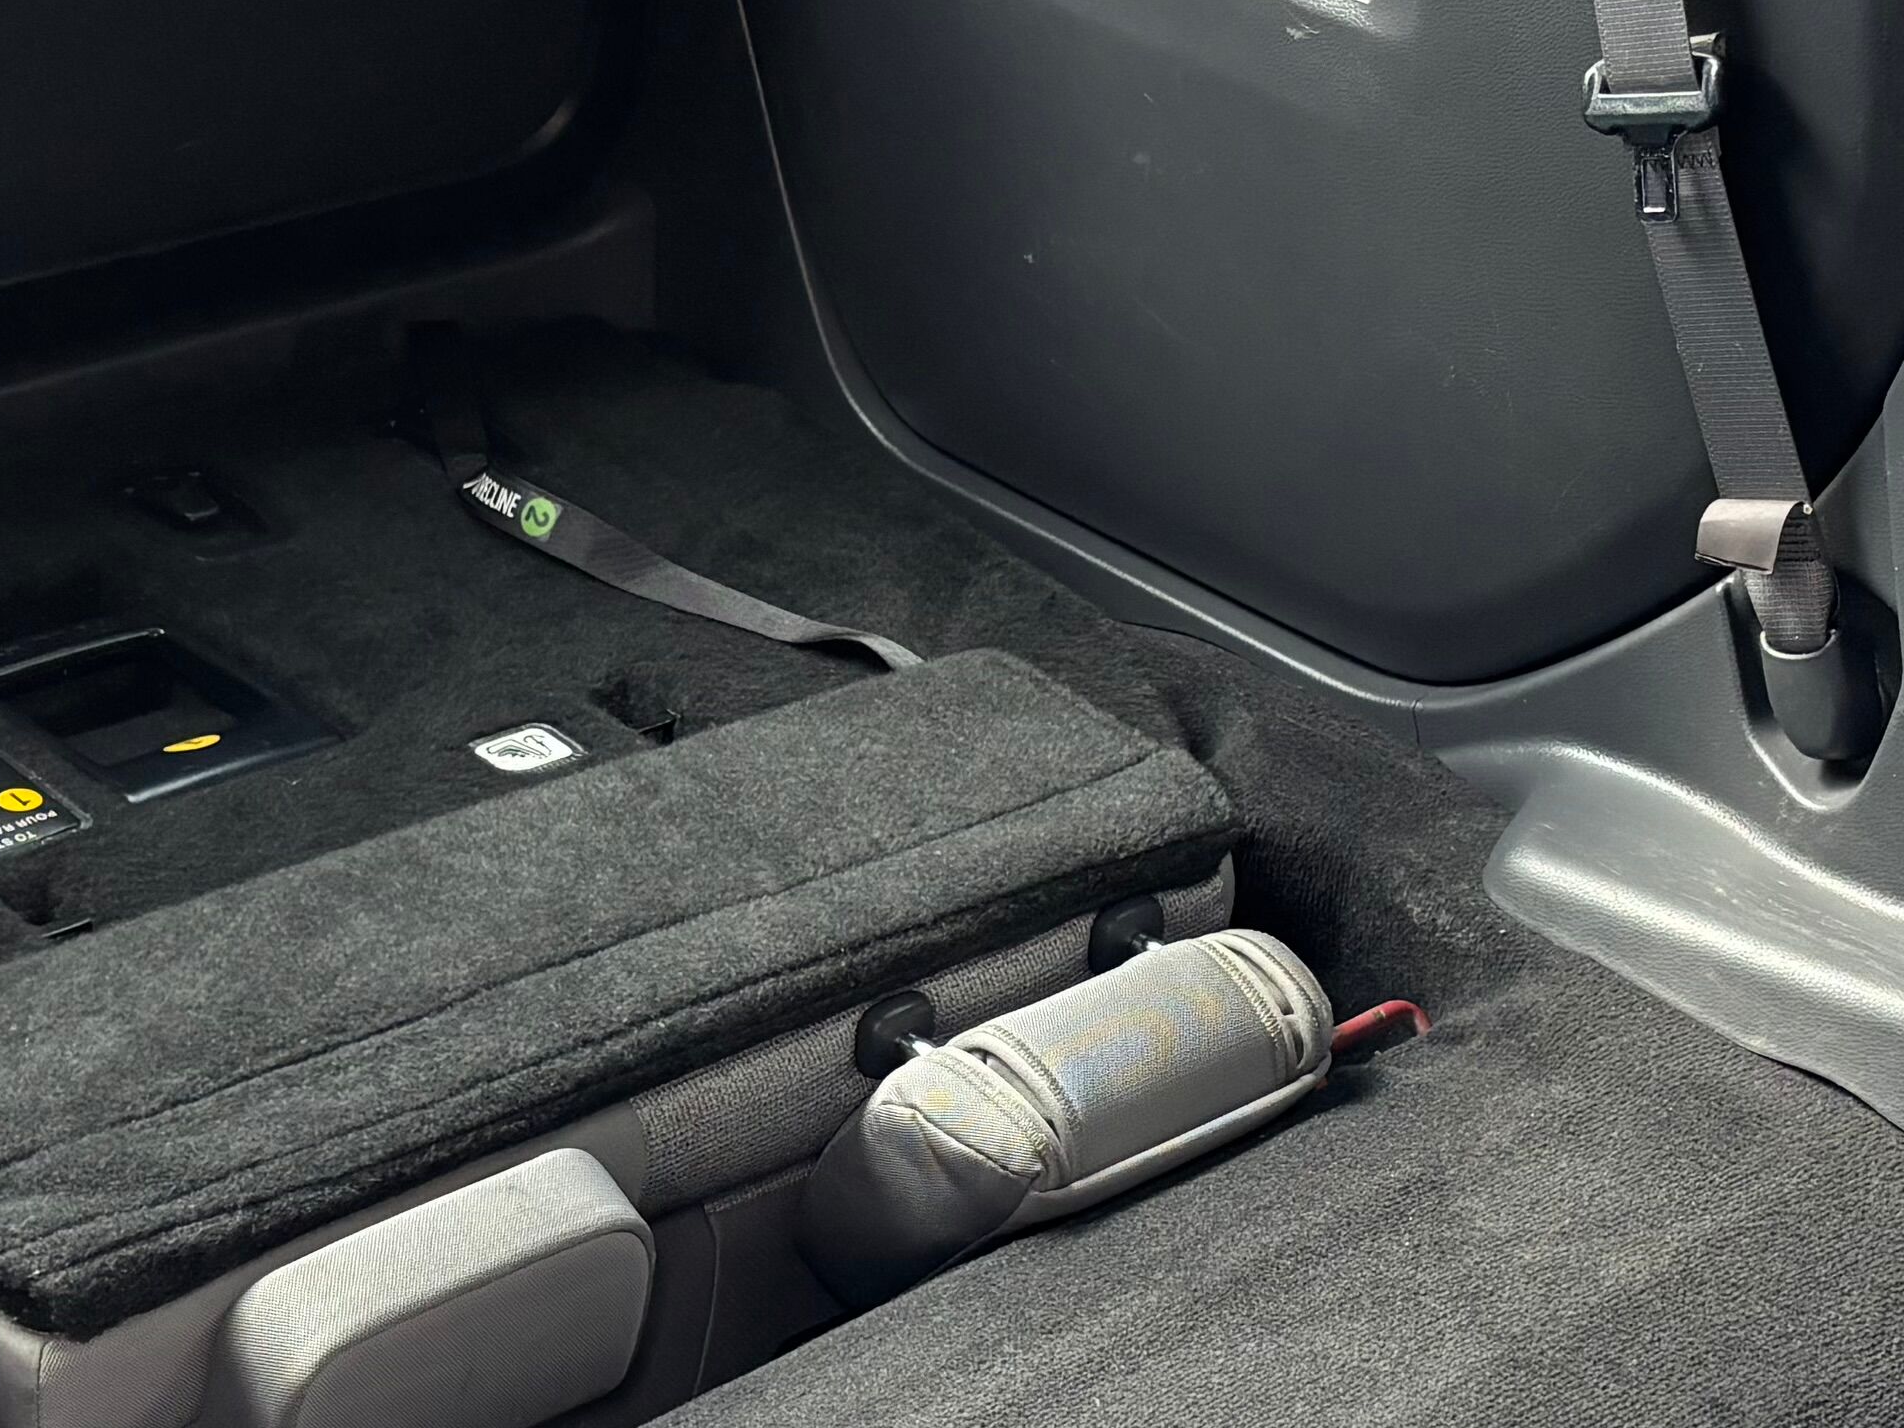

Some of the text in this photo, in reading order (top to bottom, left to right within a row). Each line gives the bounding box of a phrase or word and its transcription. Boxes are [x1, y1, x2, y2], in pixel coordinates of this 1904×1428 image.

[525, 504, 550, 528] 2
[8, 792, 32, 807] 1
[15, 809, 58, 828] POUR
[13, 830, 37, 844] TO
